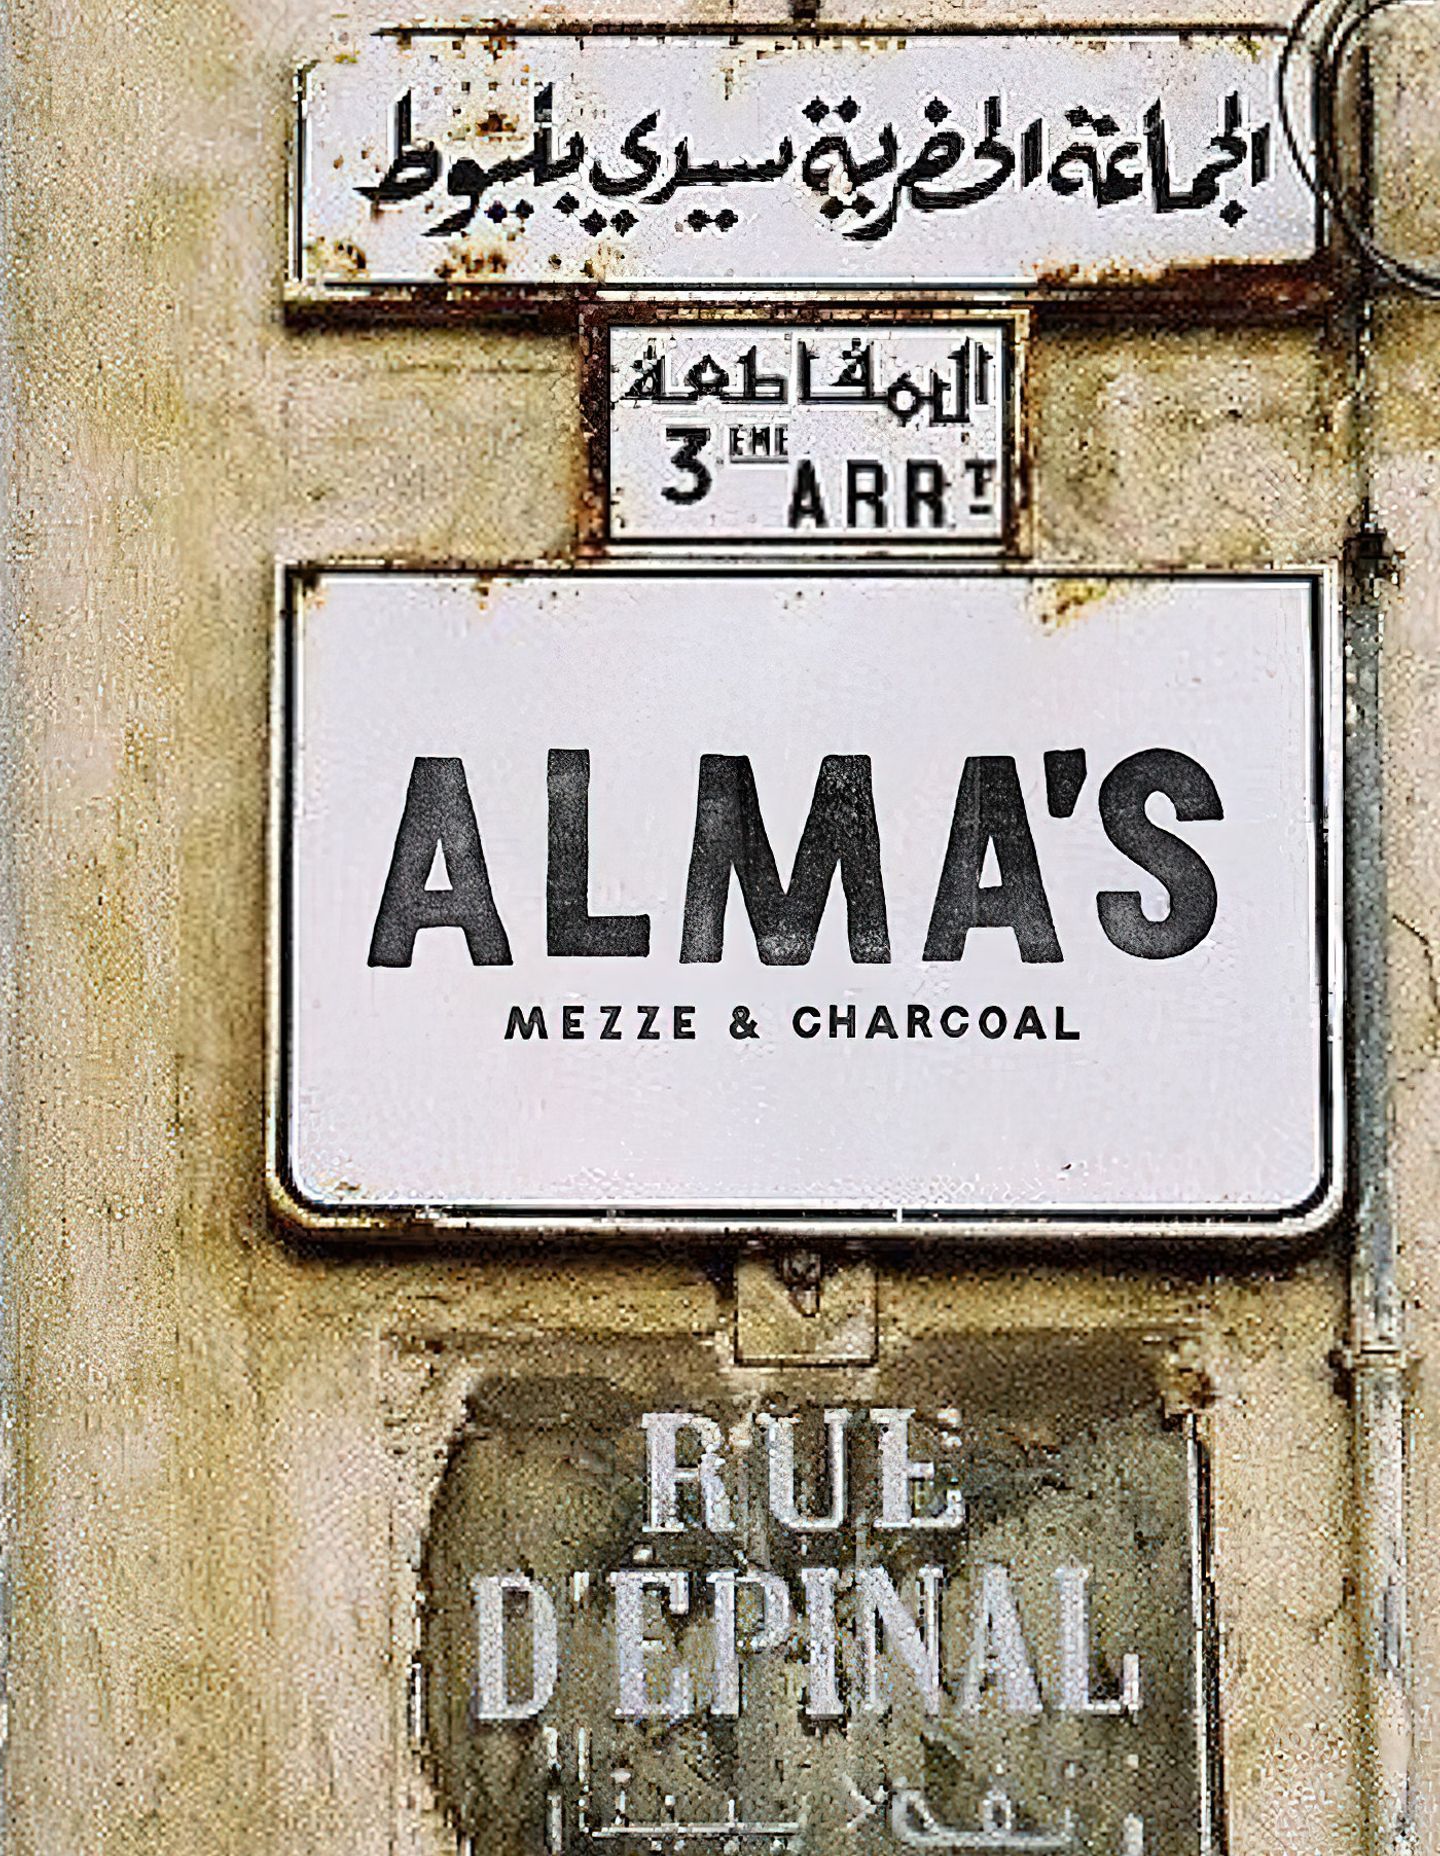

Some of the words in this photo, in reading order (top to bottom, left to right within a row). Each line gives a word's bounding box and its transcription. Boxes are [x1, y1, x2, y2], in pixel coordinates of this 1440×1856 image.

[352, 82, 585, 237] بليوط
[580, 108, 794, 237] سيدي
[802, 95, 1044, 241] الحضرية
[1050, 90, 1271, 229] الجماعة
[619, 336, 995, 425] المقاطعة
[366, 747, 1225, 968] ALMA'S
[504, 1005, 696, 1040] MEZZE
[729, 1005, 760, 1040] &
[792, 1004, 1080, 1041] CHARCOAL
[640, 1407, 966, 1534] RUE
